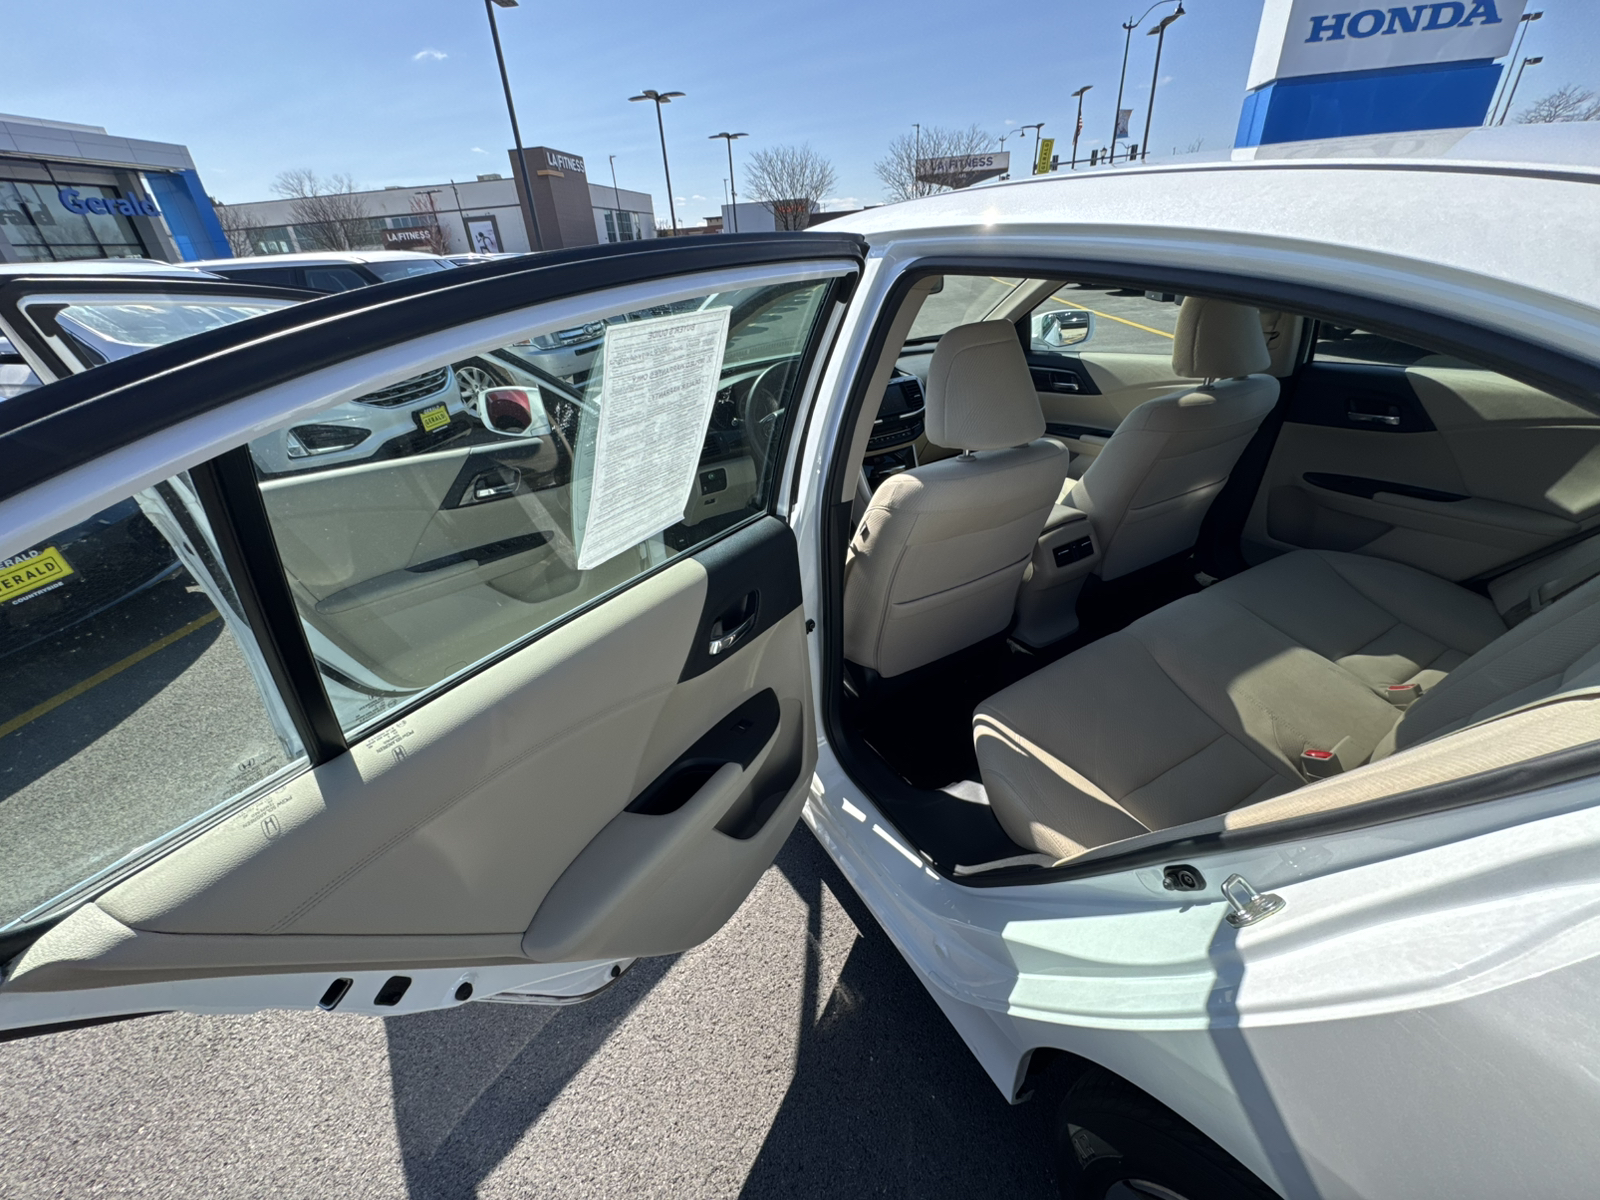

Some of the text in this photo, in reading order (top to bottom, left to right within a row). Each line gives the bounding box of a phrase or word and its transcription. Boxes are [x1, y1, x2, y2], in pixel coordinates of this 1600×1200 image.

[1304, 0, 1502, 43] HONDA
[558, 154, 585, 173] FITNESS
[58, 187, 161, 217] Gerald
[398, 230, 431, 241] FITNESS
[425, 413, 445, 425] GERALD
[0, 562, 55, 592] ERALD
[12, 581, 64, 605] COUNTRYSIDE
